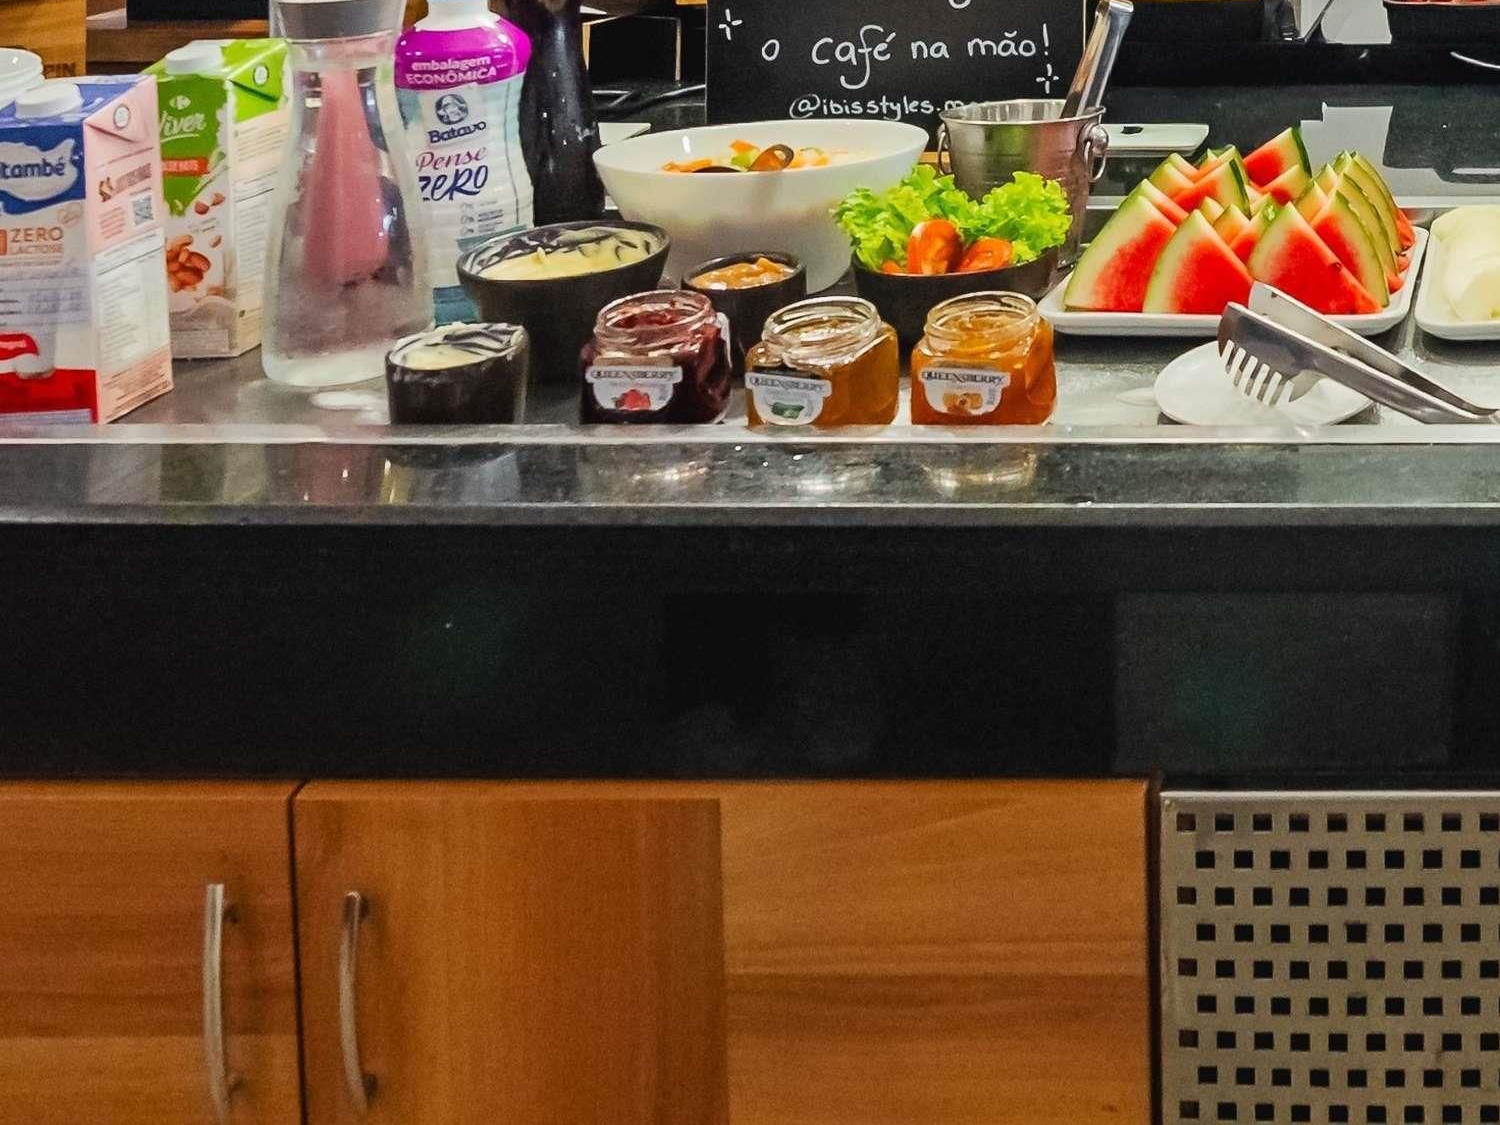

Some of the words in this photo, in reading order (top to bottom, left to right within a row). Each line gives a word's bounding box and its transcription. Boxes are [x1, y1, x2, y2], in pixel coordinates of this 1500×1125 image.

[411, 55, 491, 71] embalagem
[761, 38, 780, 62] o
[811, 24, 897, 90] café
[910, 40, 950, 60] na
[967, 23, 1050, 57] mão!
[406, 66, 497, 84] ECONÔMICA
[428, 121, 487, 144] Batavo
[416, 146, 488, 172] Pense
[10, 226, 64, 243] ZERO
